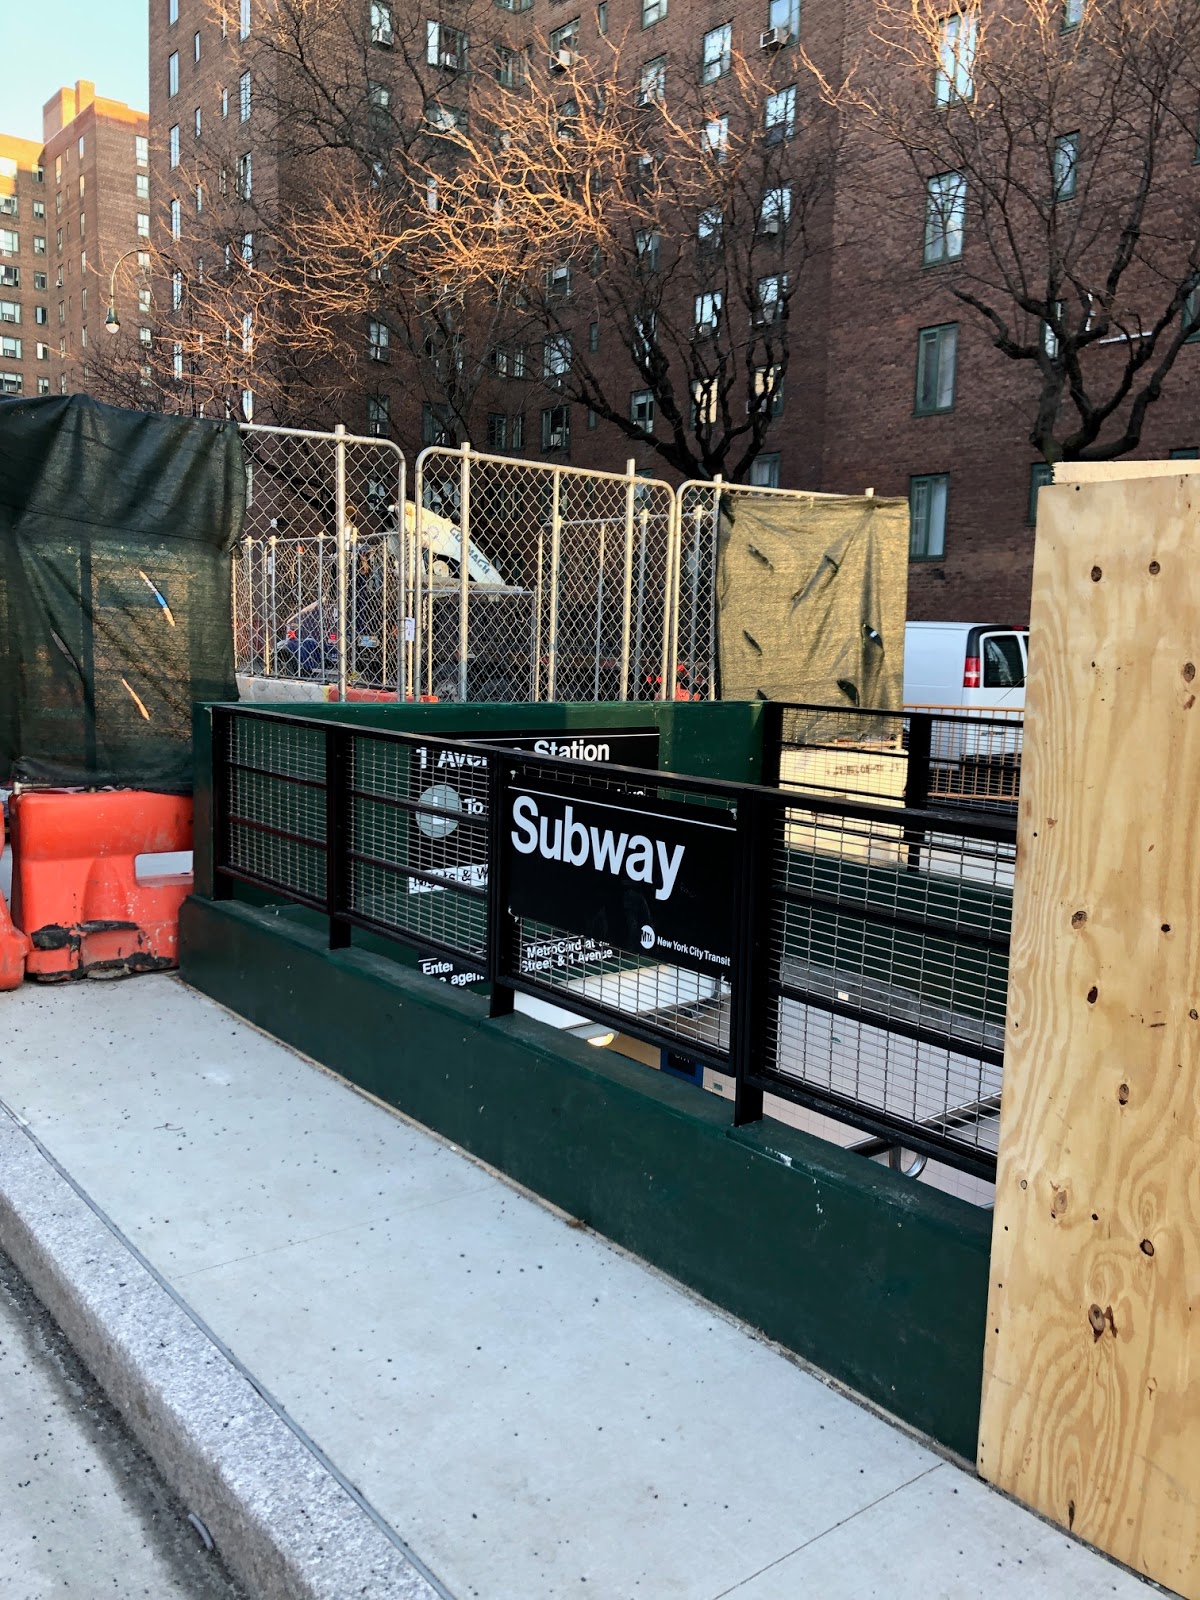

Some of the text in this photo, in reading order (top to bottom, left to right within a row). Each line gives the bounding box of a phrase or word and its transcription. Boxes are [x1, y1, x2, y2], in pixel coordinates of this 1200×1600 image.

[416, 746, 428, 769] 1
[533, 739, 610, 761] Station
[464, 797, 484, 815] To
[511, 795, 685, 900] Subway
[461, 869, 471, 882] &
[521, 957, 554, 973] Street
[557, 954, 565, 967] &
[569, 952, 575, 965] 1
[578, 948, 613, 964] Avenue
[526, 939, 582, 959] MetroCard
[585, 938, 596, 950] at
[657, 935, 731, 967] New York City Transit
